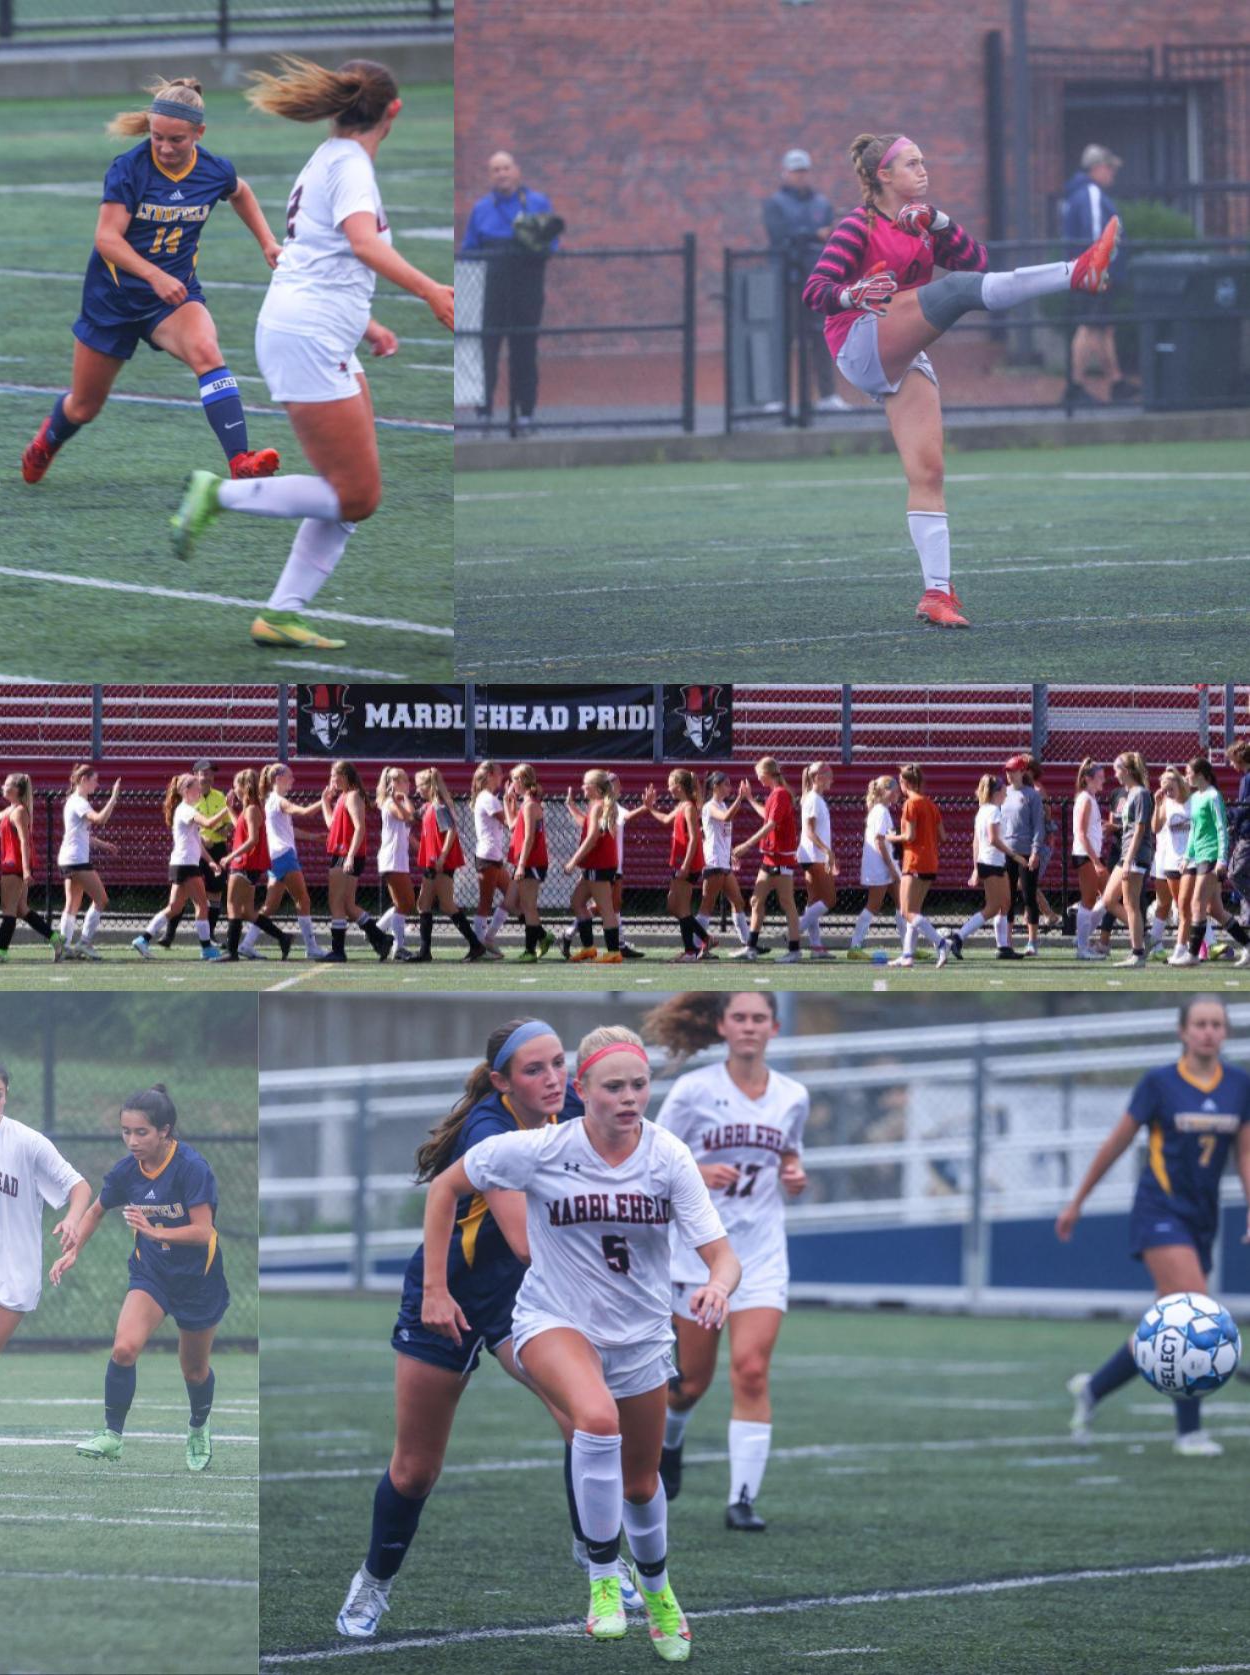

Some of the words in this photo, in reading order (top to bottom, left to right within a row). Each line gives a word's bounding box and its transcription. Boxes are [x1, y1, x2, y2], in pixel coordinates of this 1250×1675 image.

[149, 227, 182, 253] 14
[364, 703, 569, 730] MARBLEHEAD
[1198, 1135, 1217, 1168] 7
[545, 1193, 671, 1227] MARBLEHEAD
[601, 1235, 630, 1275] 5
[1160, 1334, 1177, 1388] SELECT
